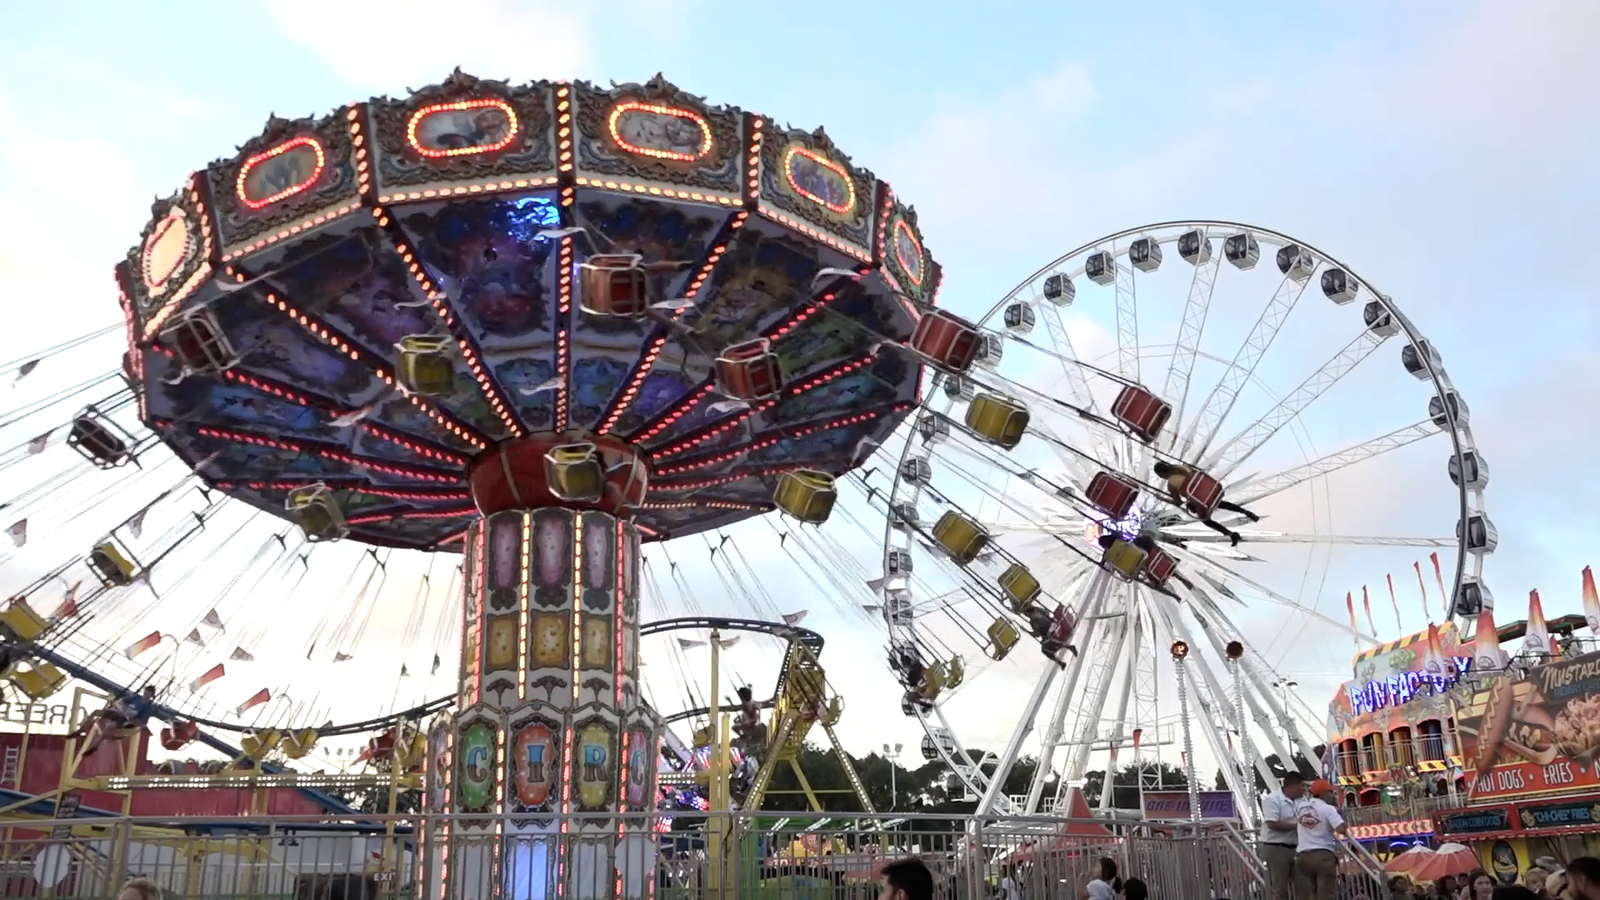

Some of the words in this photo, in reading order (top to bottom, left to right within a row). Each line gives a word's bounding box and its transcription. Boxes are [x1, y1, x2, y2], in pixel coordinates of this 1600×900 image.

[1351, 680, 1386, 716] FUN
[1477, 773, 1495, 793] HOT
[1497, 768, 1525, 790] DOGS
[1542, 761, 1574, 785] FRIES
